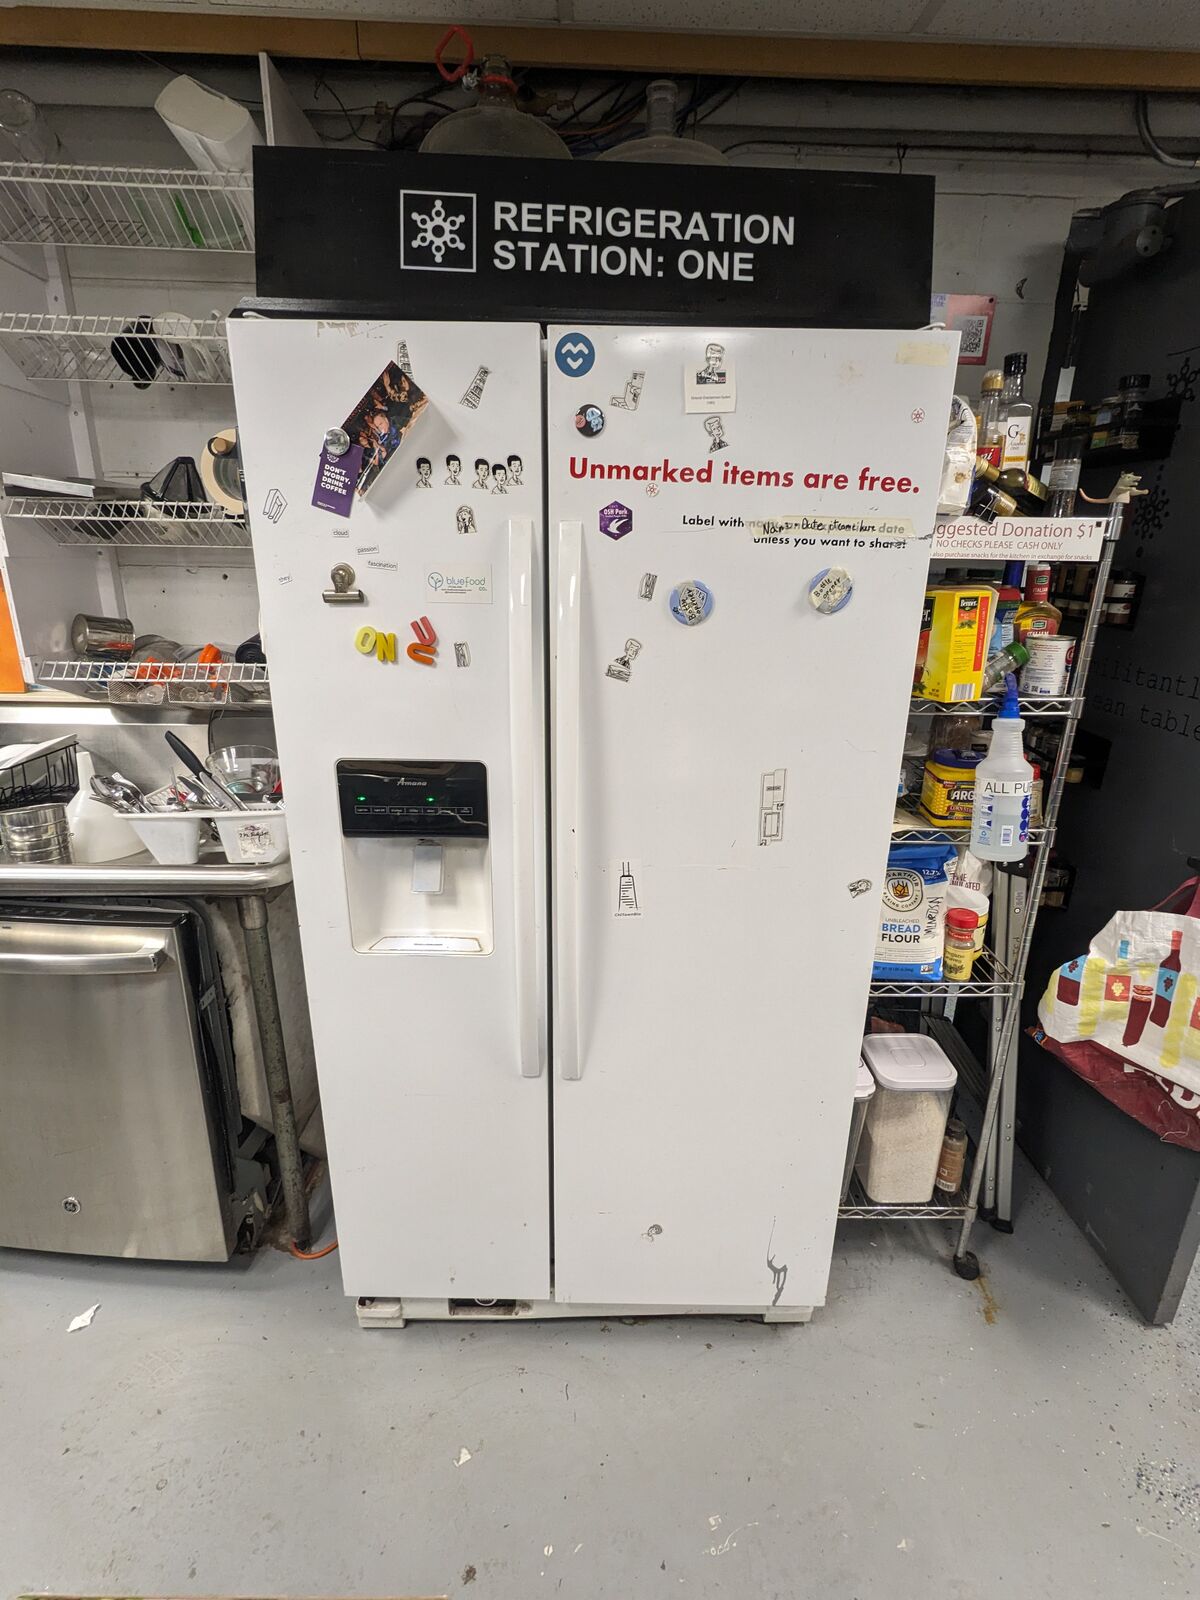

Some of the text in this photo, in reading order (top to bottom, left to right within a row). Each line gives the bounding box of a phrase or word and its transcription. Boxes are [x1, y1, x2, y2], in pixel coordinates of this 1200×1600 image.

[493, 200, 795, 246] REFRIGERATION
[493, 240, 754, 282] STATION: ONE
[325, 464, 347, 476] DON'T
[569, 456, 920, 494] Unmarked items are free.
[322, 476, 344, 488] DRINK
[323, 470, 351, 485] WORRY,
[320, 482, 347, 496] COFFEE
[682, 515, 715, 527] Label
[718, 517, 745, 528] with
[934, 522, 1094, 539] ggested Donation $1
[793, 537, 817, 548] you
[820, 537, 850, 548] want
[853, 538, 865, 548] to
[936, 540, 1063, 550] NO CHECKS PLEASE CASH ONLY
[357, 546, 377, 554] passion
[368, 560, 397, 569] fascination
[813, 577, 833, 598] Bottle
[397, 777, 428, 786] Amana
[984, 782, 1010, 794] ALL
[951, 790, 975, 800] ARG
[882, 923, 921, 933] BREAD
[881, 934, 921, 944] FLOUR
